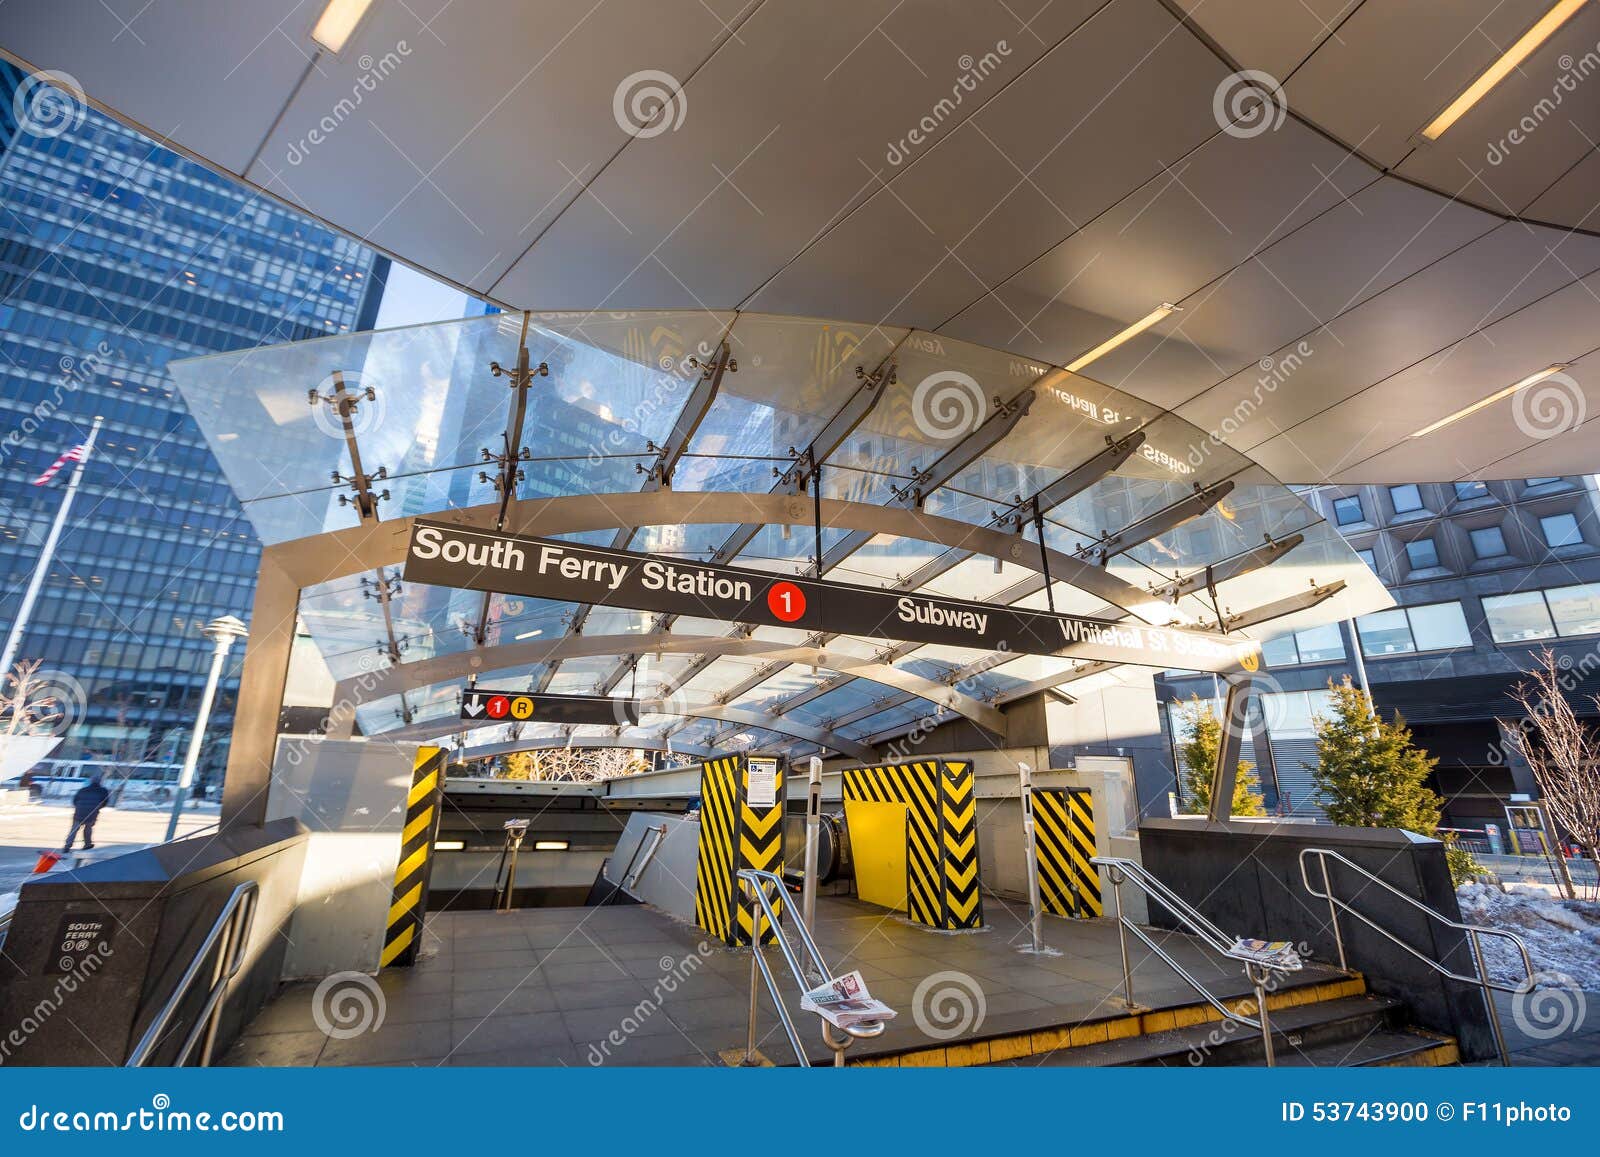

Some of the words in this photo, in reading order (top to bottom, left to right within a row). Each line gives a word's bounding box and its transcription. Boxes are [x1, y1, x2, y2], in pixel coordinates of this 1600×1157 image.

[412, 528, 525, 571] South
[538, 546, 628, 590] Ferry
[641, 562, 751, 601] Station
[780, 591, 791, 613] 1
[898, 598, 988, 635] Subway
[1058, 618, 1144, 648] Whitehall
[68, 923, 103, 931] SOUTH
